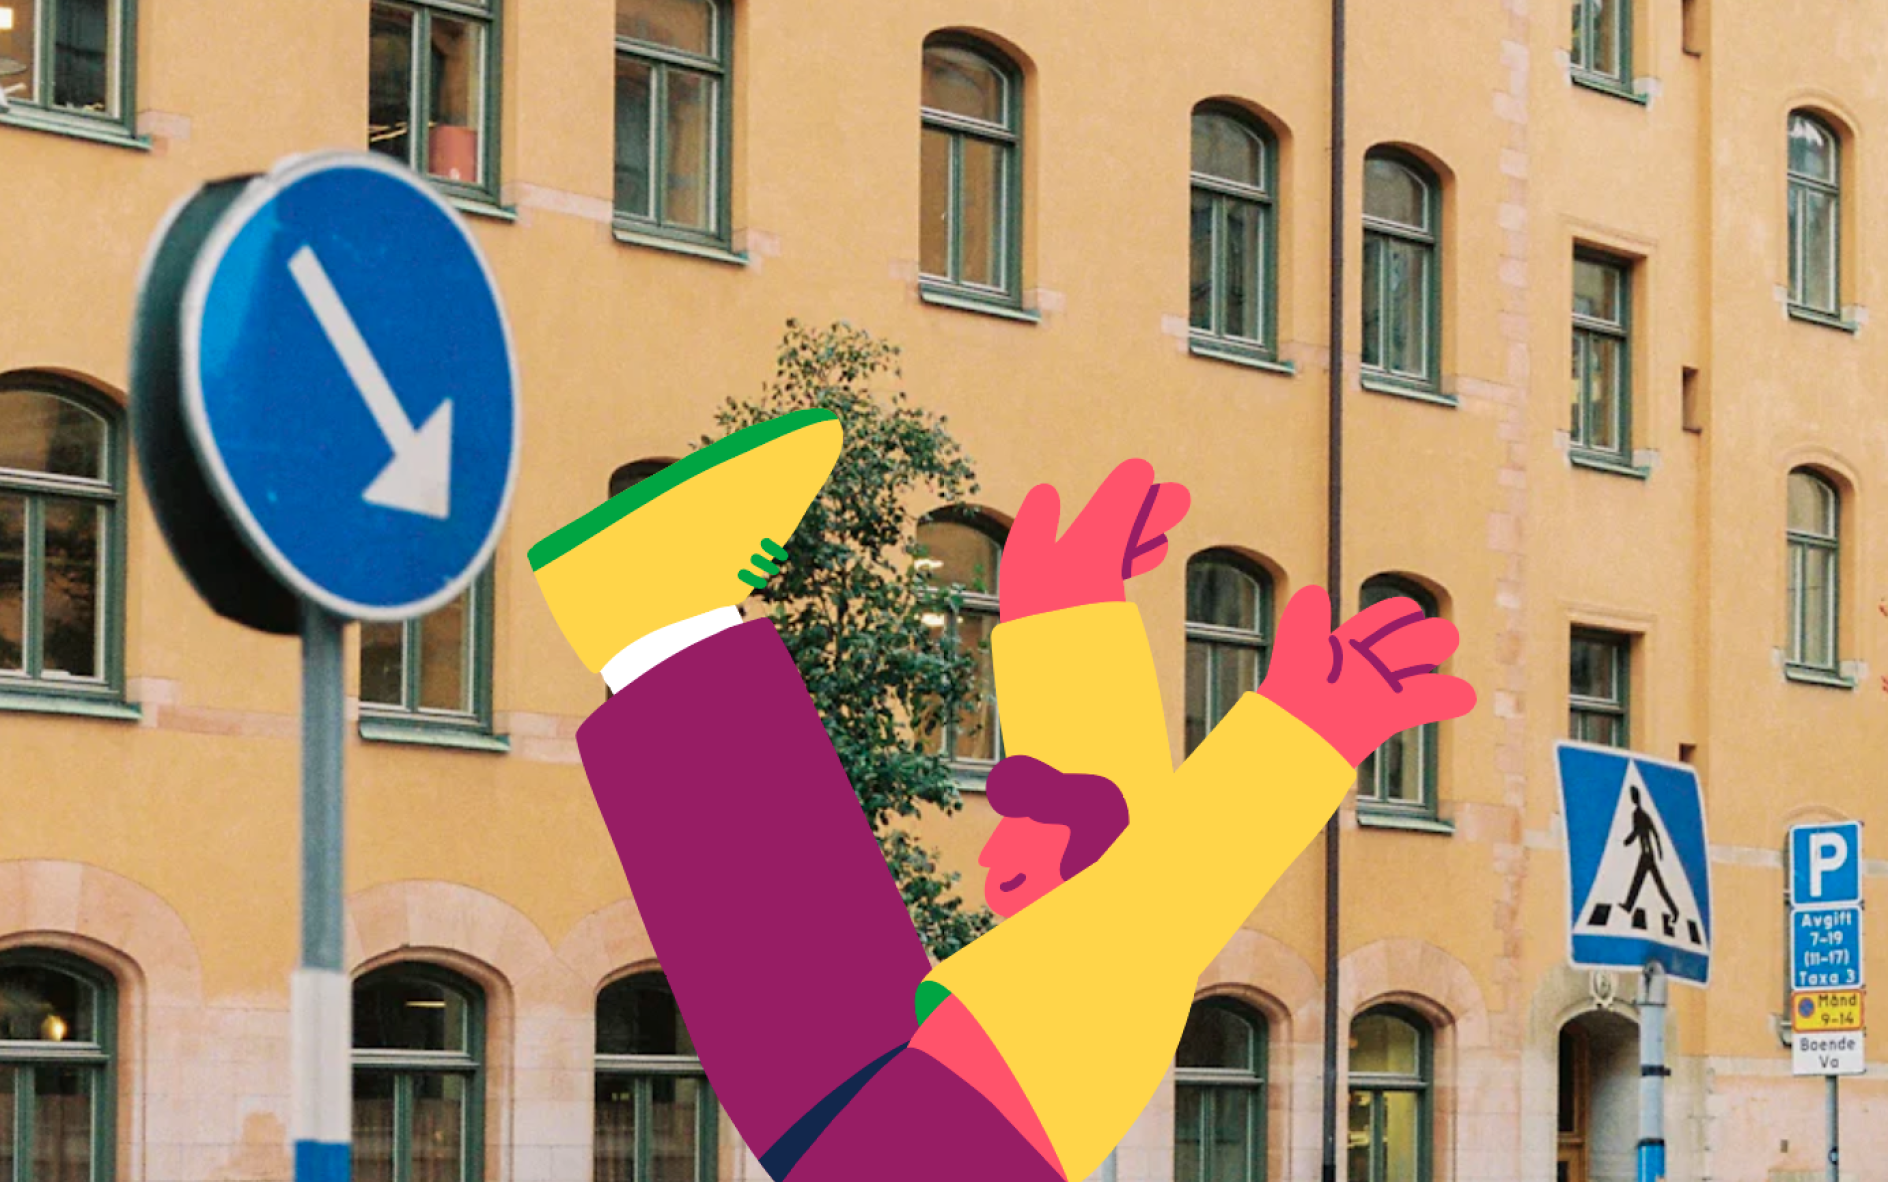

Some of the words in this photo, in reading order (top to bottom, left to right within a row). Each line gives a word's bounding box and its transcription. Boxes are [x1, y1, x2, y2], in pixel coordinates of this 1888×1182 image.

[1808, 832, 1847, 897] P
[1801, 911, 1852, 930] Avgift
[1809, 930, 1844, 947] 7-19
[1804, 948, 1850, 968] (11-17)
[1799, 970, 1839, 986] Taxa
[1846, 968, 1855, 983] 3
[1818, 992, 1856, 1009] Månd
[1820, 1011, 1855, 1026] 9-14
[1799, 1035, 1856, 1051] Boende
[1819, 1054, 1840, 1069] Va
